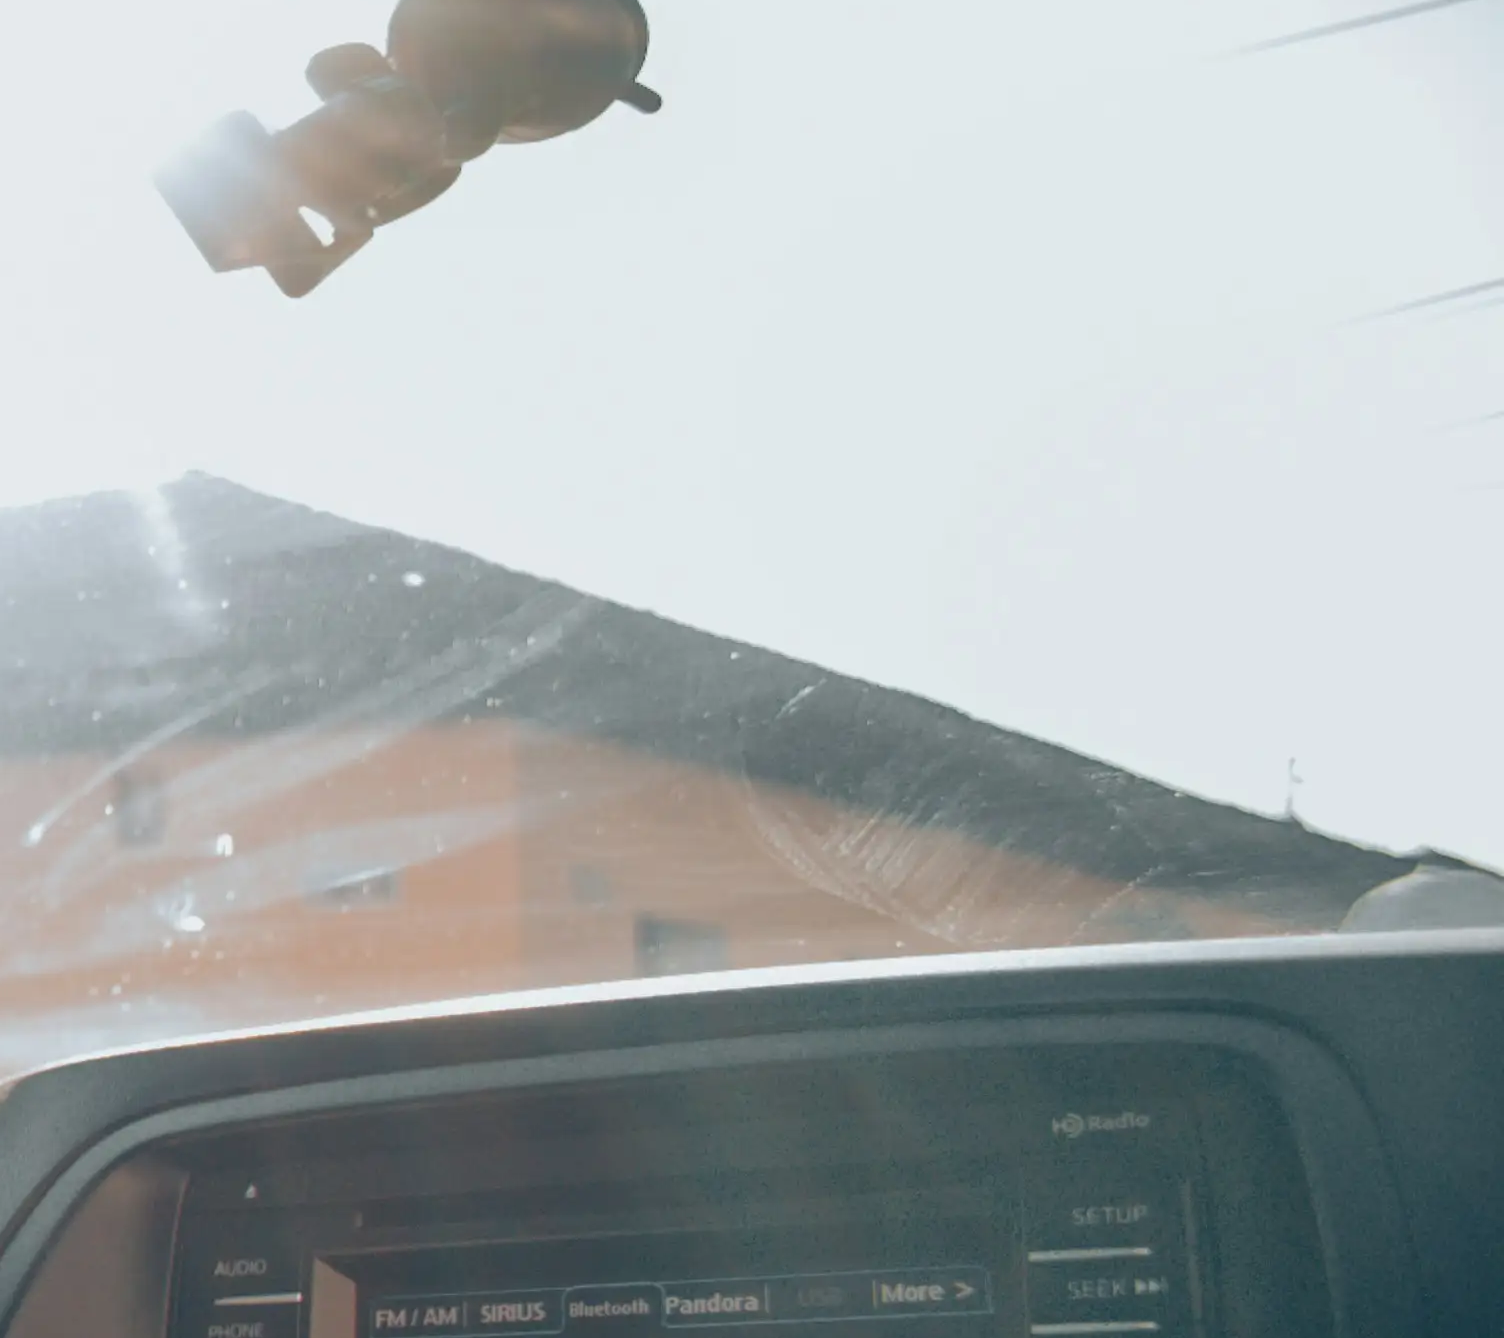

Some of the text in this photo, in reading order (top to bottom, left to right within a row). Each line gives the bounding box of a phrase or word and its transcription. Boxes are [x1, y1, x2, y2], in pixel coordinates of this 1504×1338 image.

[1070, 1204, 1149, 1228] SETUP
[213, 1256, 269, 1278] AUDIO
[879, 1280, 945, 1303] More
[1067, 1276, 1129, 1301] SEEK
[479, 1300, 548, 1324] SIRIUS
[569, 1297, 650, 1318] Bluetooth
[666, 1291, 760, 1315] Pandora
[374, 1308, 404, 1328] FM
[422, 1305, 458, 1326] AM
